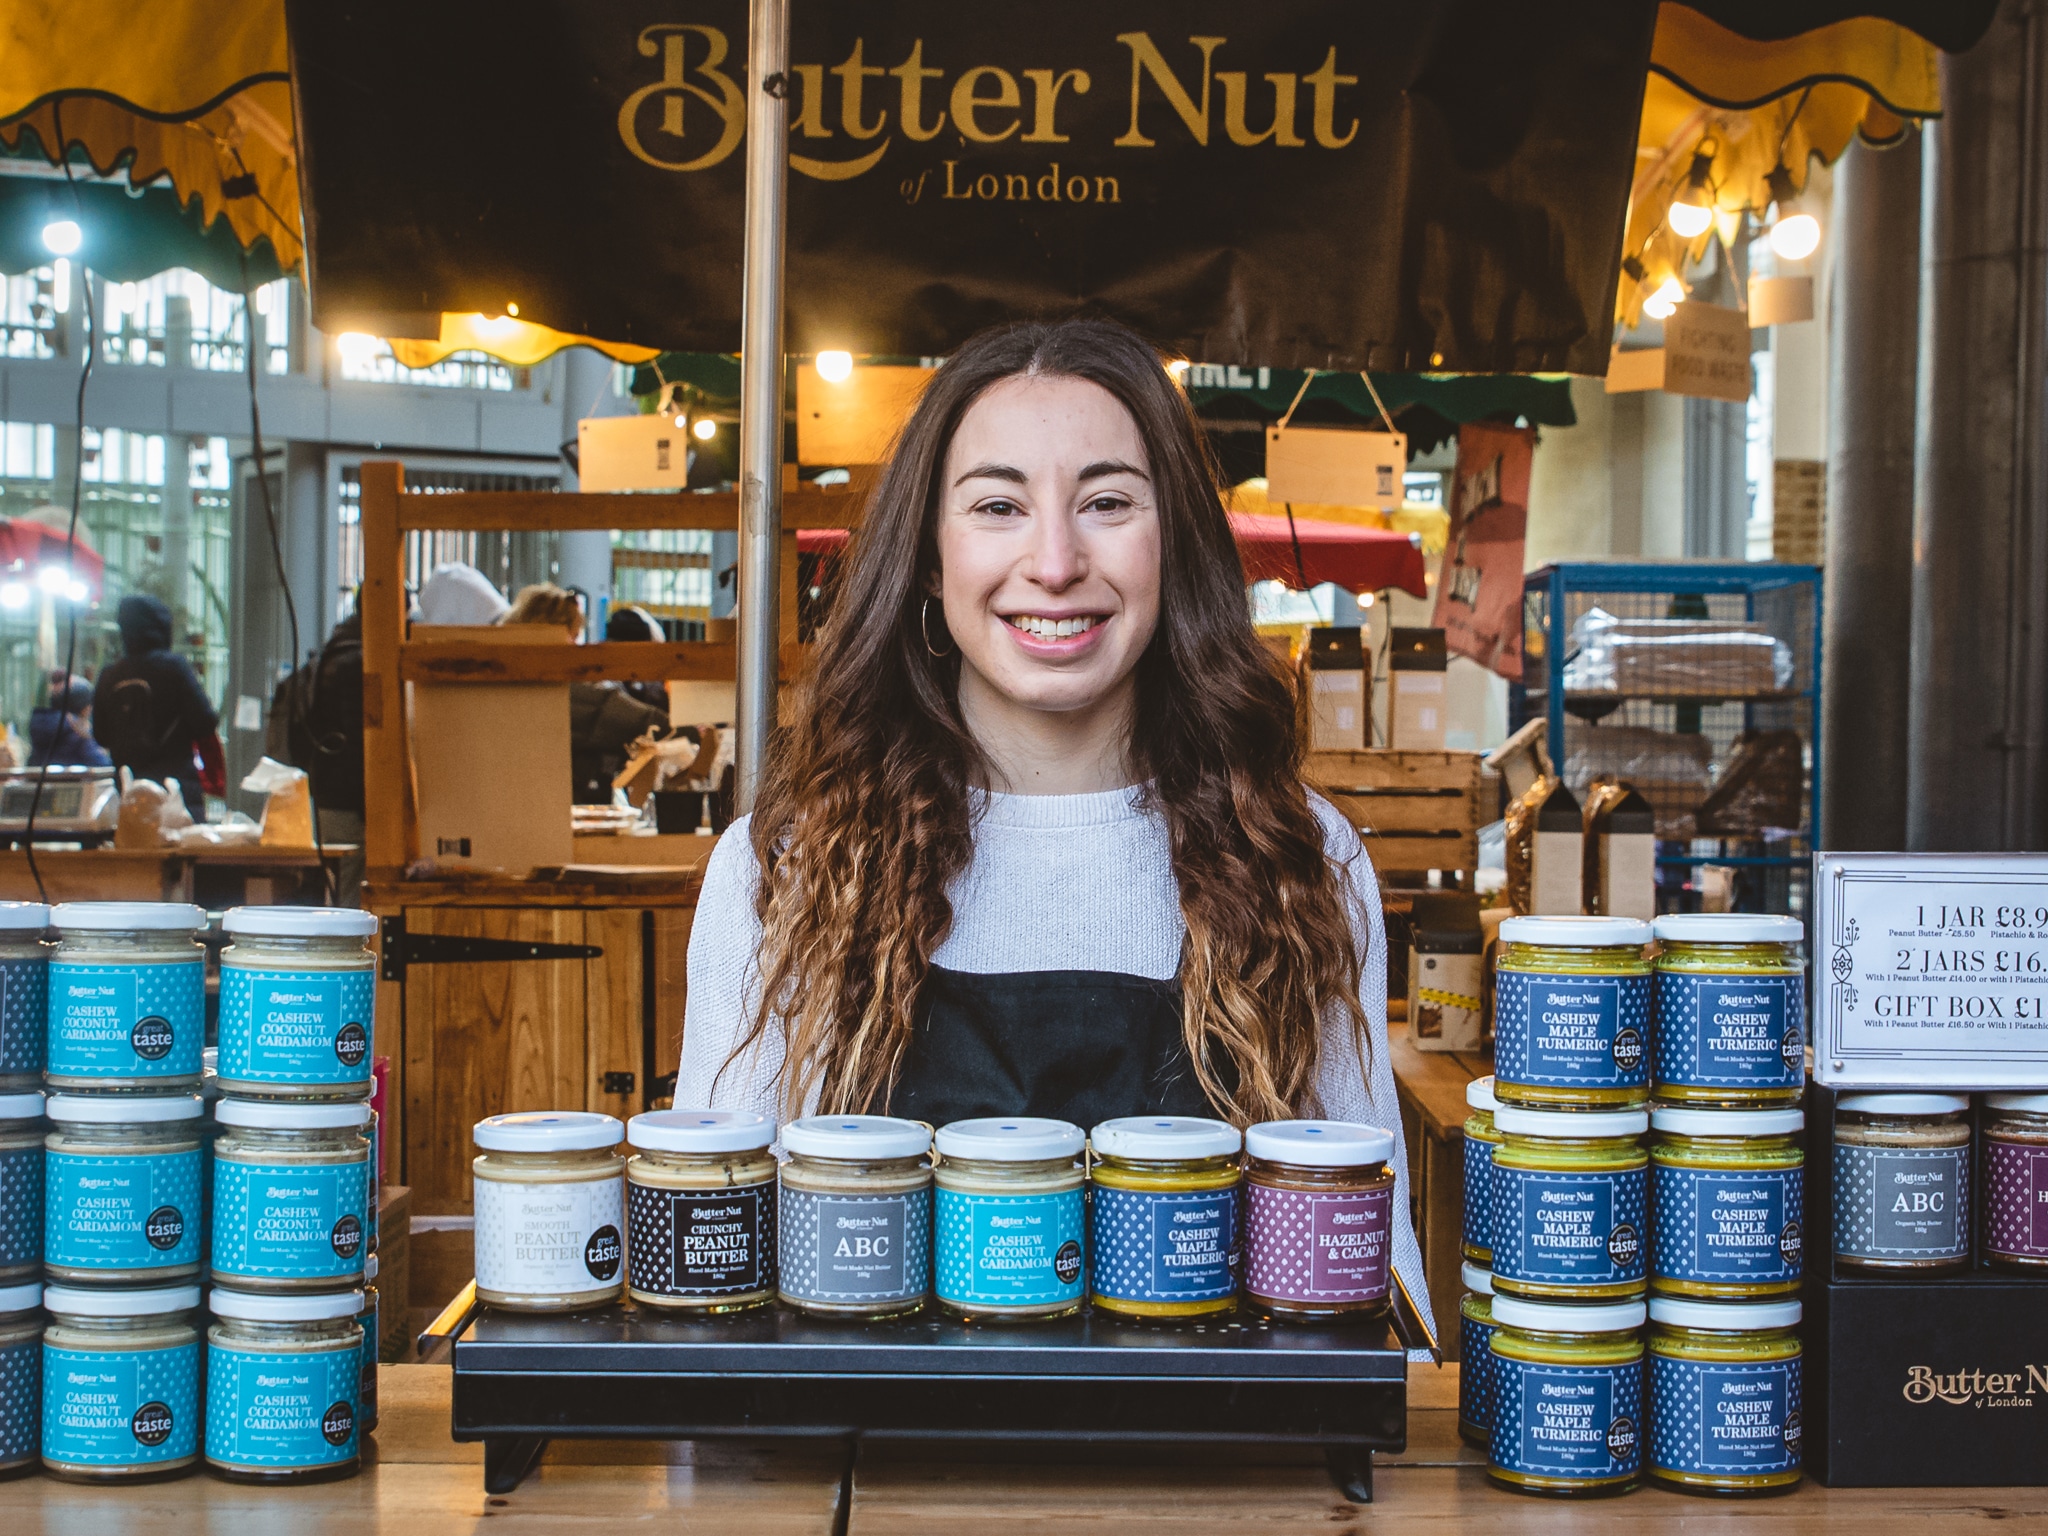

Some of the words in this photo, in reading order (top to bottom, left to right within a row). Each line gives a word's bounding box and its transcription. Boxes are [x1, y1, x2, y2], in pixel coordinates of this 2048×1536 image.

[1115, 32, 1360, 149] Nut
[900, 168, 932, 205] of
[943, 161, 1121, 203] London
[1917, 906, 1925, 926] 1
[1937, 906, 1986, 929] JAR
[1897, 950, 1910, 970] 2
[1920, 950, 1984, 973] JARS
[1547, 993, 1582, 1006] Butter
[1583, 994, 1600, 1004] Nut
[1719, 994, 1753, 1007] Butter
[1754, 995, 1770, 1004] Nut
[67, 1005, 117, 1016] CASHEW
[1875, 995, 1938, 1016] GIFT
[1948, 996, 2004, 1018] BOX
[63, 1017, 120, 1028] COCONUT
[267, 1012, 324, 1023] CASHEW
[1542, 1012, 1600, 1025] CASHEW
[1714, 1013, 1770, 1025] CASHEW
[61, 1028, 127, 1040] CARDAMOM
[261, 1024, 326, 1035] COCONUT
[1549, 1025, 1596, 1037] MAPLE
[1721, 1026, 1766, 1038] MAPLE
[133, 1033, 172, 1046] taste
[257, 1035, 331, 1047] CARDAMOM
[1537, 1037, 1608, 1050] TURMERIC
[1707, 1038, 1777, 1050] TURMERIC
[336, 1040, 365, 1052] taste
[1614, 1044, 1640, 1057] taste
[1782, 1044, 1802, 1056] taste
[1894, 1172, 1927, 1184] Butter
[1928, 1172, 1942, 1181] Nut
[1541, 1191, 1576, 1203] Butter
[1577, 1192, 1594, 1201] Nut
[1717, 1190, 1751, 1202] Butter
[1752, 1190, 1768, 1200] Nut
[1891, 1192, 1944, 1212] ABC
[77, 1197, 132, 1208] CASHEW
[72, 1209, 134, 1220] COCONUT
[264, 1207, 320, 1218] CASHEW
[522, 1204, 554, 1216] Butter
[556, 1204, 572, 1212] Nut
[692, 1208, 725, 1220] Butter
[726, 1207, 742, 1216] Nut
[1174, 1211, 1205, 1223] Butter
[1206, 1209, 1219, 1219] Nut
[1536, 1210, 1595, 1222] CASHEW
[1712, 1209, 1768, 1220] CASHEW
[258, 1218, 322, 1229] COCONUT
[836, 1217, 871, 1229] Butter
[871, 1217, 888, 1226] Nut
[1333, 1212, 1364, 1224] Butter
[1365, 1211, 1377, 1220] Nut
[69, 1220, 142, 1232] CARDAMOM
[148, 1223, 182, 1236] taste
[524, 1221, 570, 1230] SMOOTH
[691, 1223, 743, 1234] CRUNCHY
[1544, 1223, 1590, 1235] MAPLE
[1719, 1222, 1765, 1233] MAPLE
[254, 1230, 328, 1241] CARDAMOM
[334, 1232, 360, 1245] taste
[514, 1232, 580, 1244] PEANUT
[1169, 1227, 1220, 1241] CASHEW
[1319, 1230, 1384, 1246] HAZELNUT
[1706, 1234, 1775, 1246] TURMERIC
[683, 1233, 750, 1250] PEANUT
[834, 1236, 889, 1257] ABC
[989, 1235, 1043, 1246] CASHEW
[1176, 1240, 1217, 1253] MAPLE
[1532, 1234, 1602, 1248] TURMERIC
[1609, 1240, 1637, 1253] taste
[1781, 1238, 1800, 1251] taste
[516, 1247, 580, 1260] BUTTER
[588, 1245, 619, 1262] taste
[685, 1249, 748, 1265] BUTTER
[983, 1246, 1045, 1258] COCONUT
[1328, 1248, 1339, 1259] &
[1342, 1245, 1379, 1259] CACAO
[980, 1257, 1051, 1269] CARDAMOM
[1056, 1256, 1080, 1271] taste
[1163, 1251, 1225, 1266] TURMERIC
[1542, 1384, 1576, 1397] Butter
[1577, 1385, 1594, 1395] Nut
[1722, 1383, 1756, 1395] Butter
[1757, 1382, 1772, 1391] Nut
[1903, 1366, 2021, 1404] Butter
[66, 1392, 118, 1404] CASHEW
[254, 1395, 310, 1405] CASHEW
[1975, 1398, 1984, 1408] of
[1988, 1396, 2032, 1406] London
[62, 1403, 120, 1416] COCONUT
[248, 1406, 312, 1417] COCONUT
[1537, 1402, 1595, 1415] CASHEW
[1717, 1401, 1773, 1413] CASHEW
[59, 1415, 128, 1428] CARDAMOM
[134, 1418, 171, 1433] taste
[244, 1418, 319, 1430] CARDAMOM
[324, 1418, 351, 1433] taste
[1544, 1416, 1590, 1428] MAPLE
[1725, 1414, 1769, 1426] MAPLE
[1531, 1427, 1602, 1441] TURMERIC
[1712, 1425, 1780, 1438] TURMERIC
[1608, 1433, 1634, 1447] taste
